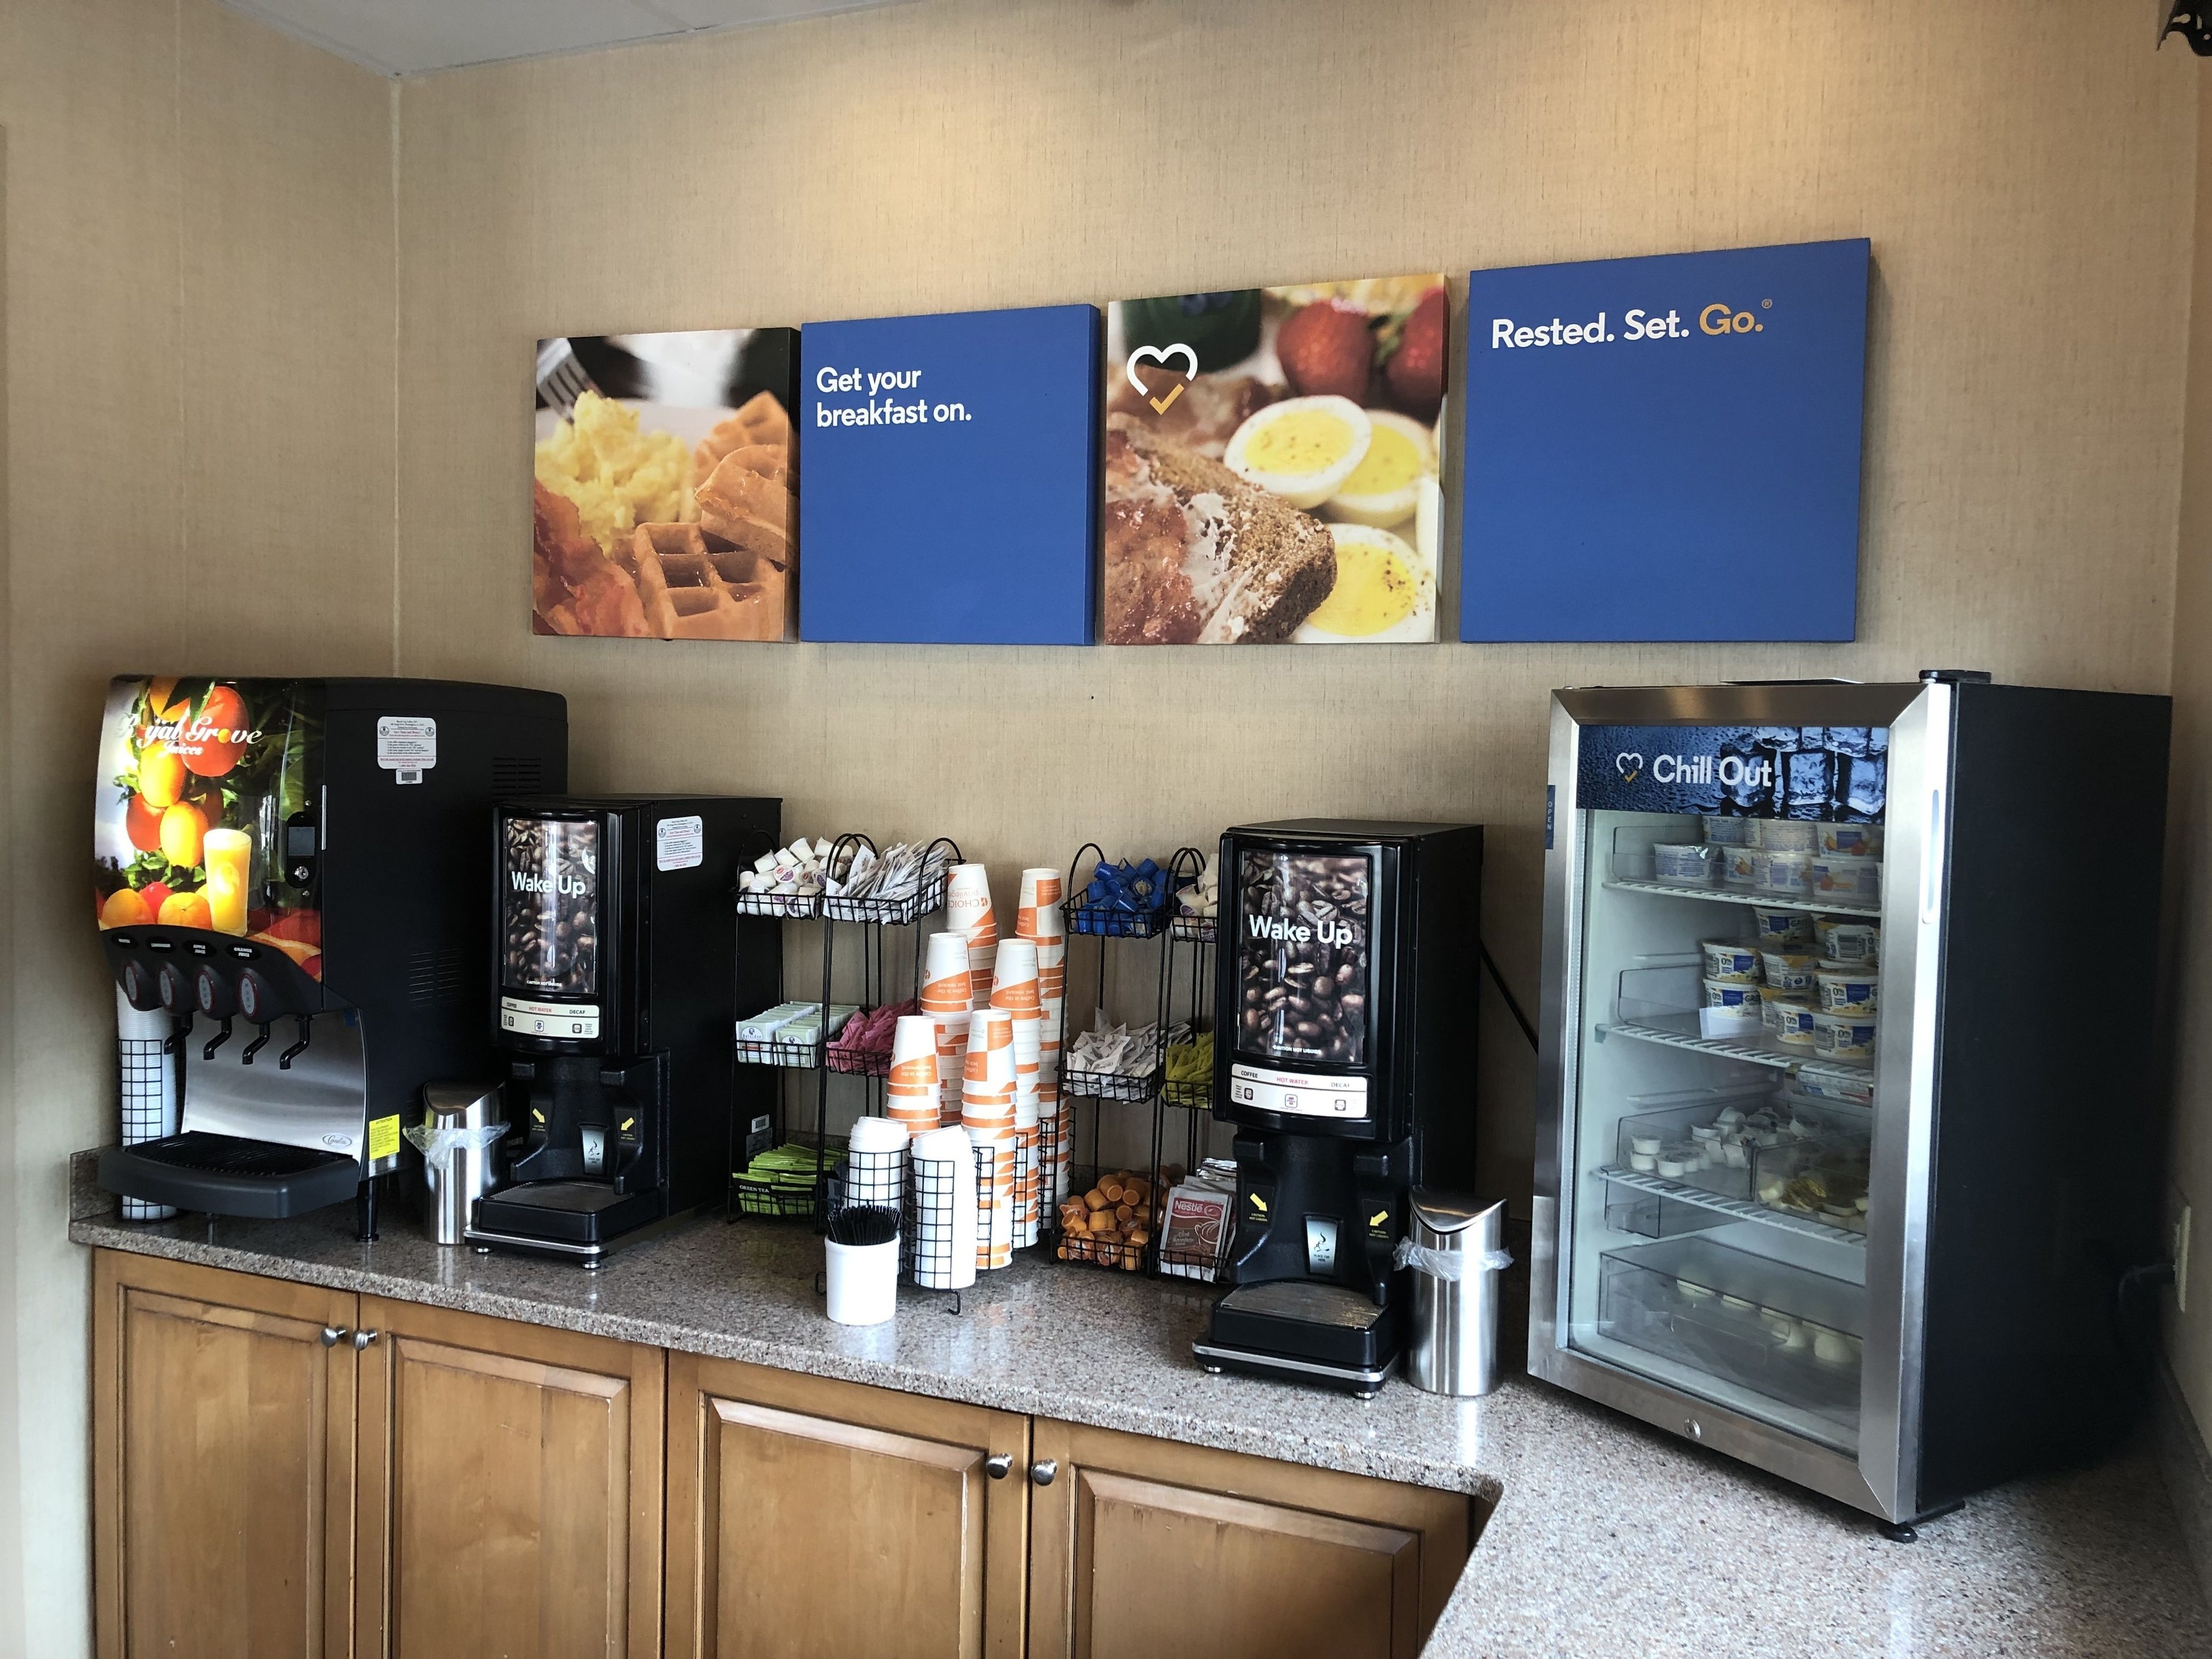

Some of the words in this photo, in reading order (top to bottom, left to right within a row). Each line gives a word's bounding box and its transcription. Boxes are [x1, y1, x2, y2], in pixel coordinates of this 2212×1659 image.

[1492, 312, 1615, 349] Rested.
[1623, 309, 1690, 340] Set.
[816, 366, 862, 393] Get
[867, 370, 922, 396] your
[817, 398, 927, 427] breakfast
[933, 403, 972, 422] on.
[1653, 754, 1712, 785] Chill
[1719, 756, 1772, 787] Out
[511, 870, 554, 893] Wake
[558, 874, 586, 899] Up
[1249, 914, 1310, 942] Wake
[1317, 920, 1353, 949] Up
[1241, 1070, 1258, 1078] COFFEE
